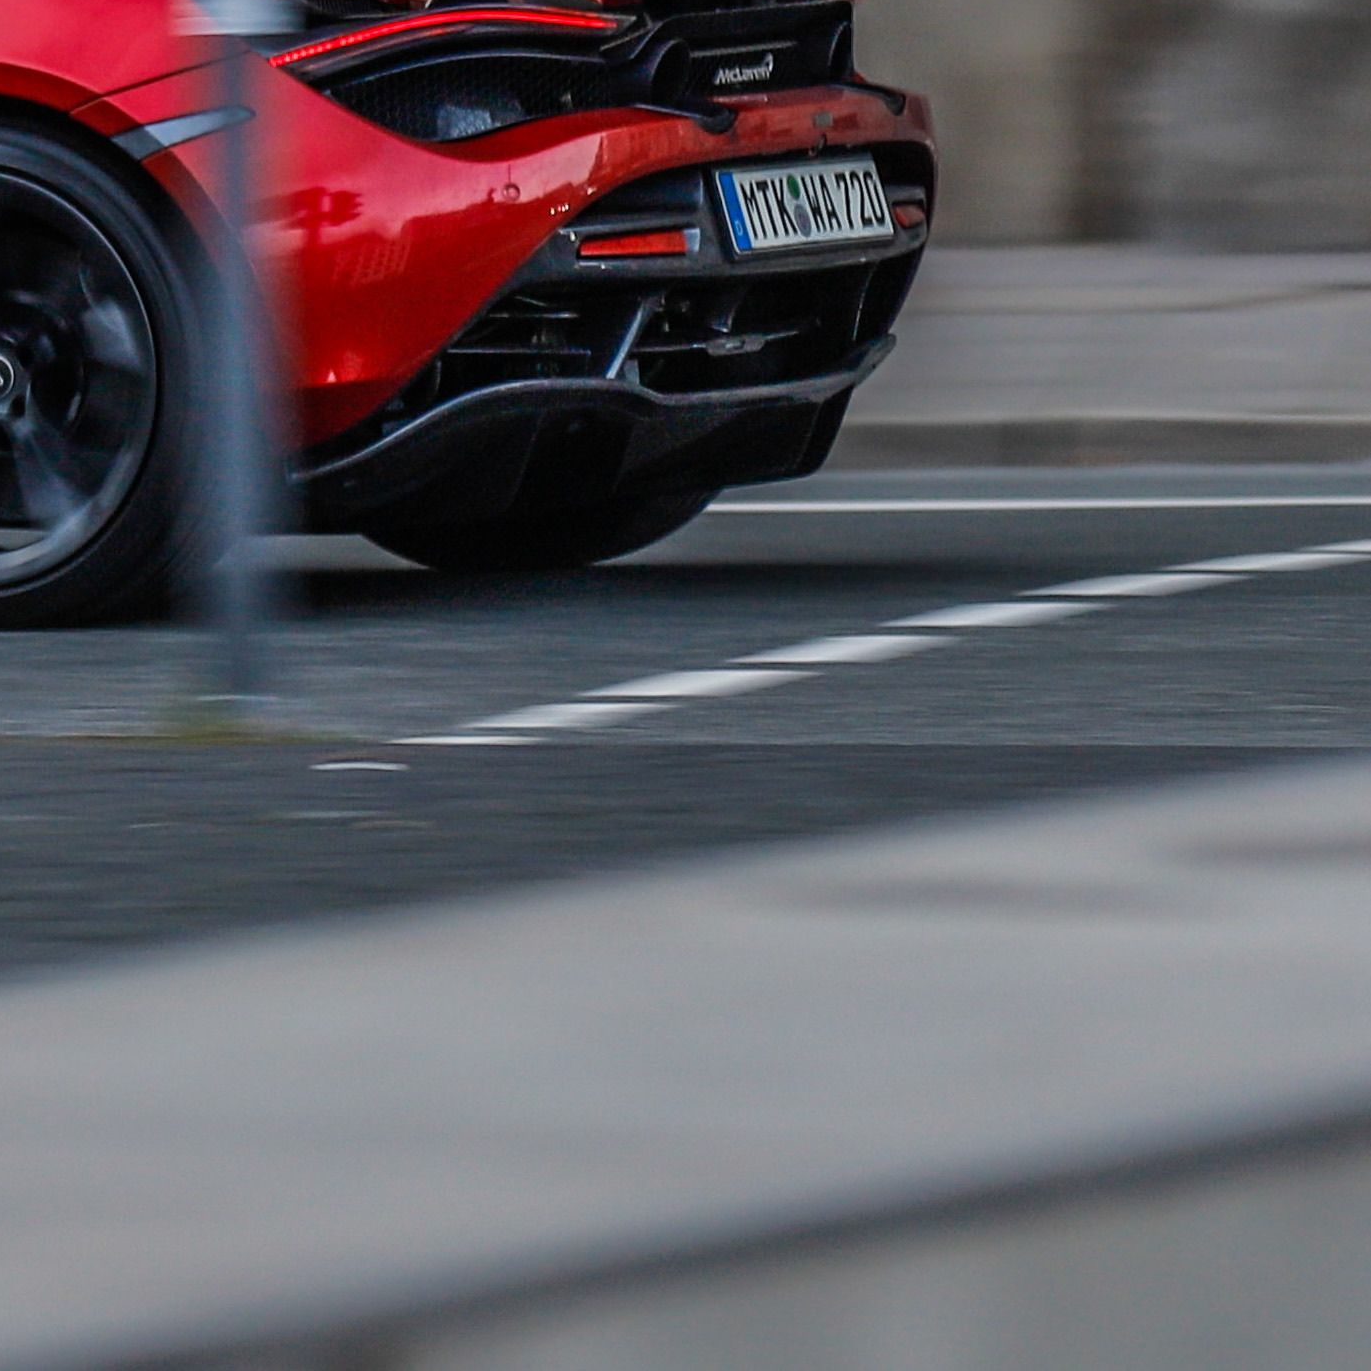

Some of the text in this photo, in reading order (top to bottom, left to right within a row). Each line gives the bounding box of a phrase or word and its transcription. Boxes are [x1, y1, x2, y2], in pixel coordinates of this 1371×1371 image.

[714, 62, 772, 85] McLaren
[739, 171, 886, 240] MTK WA 720
